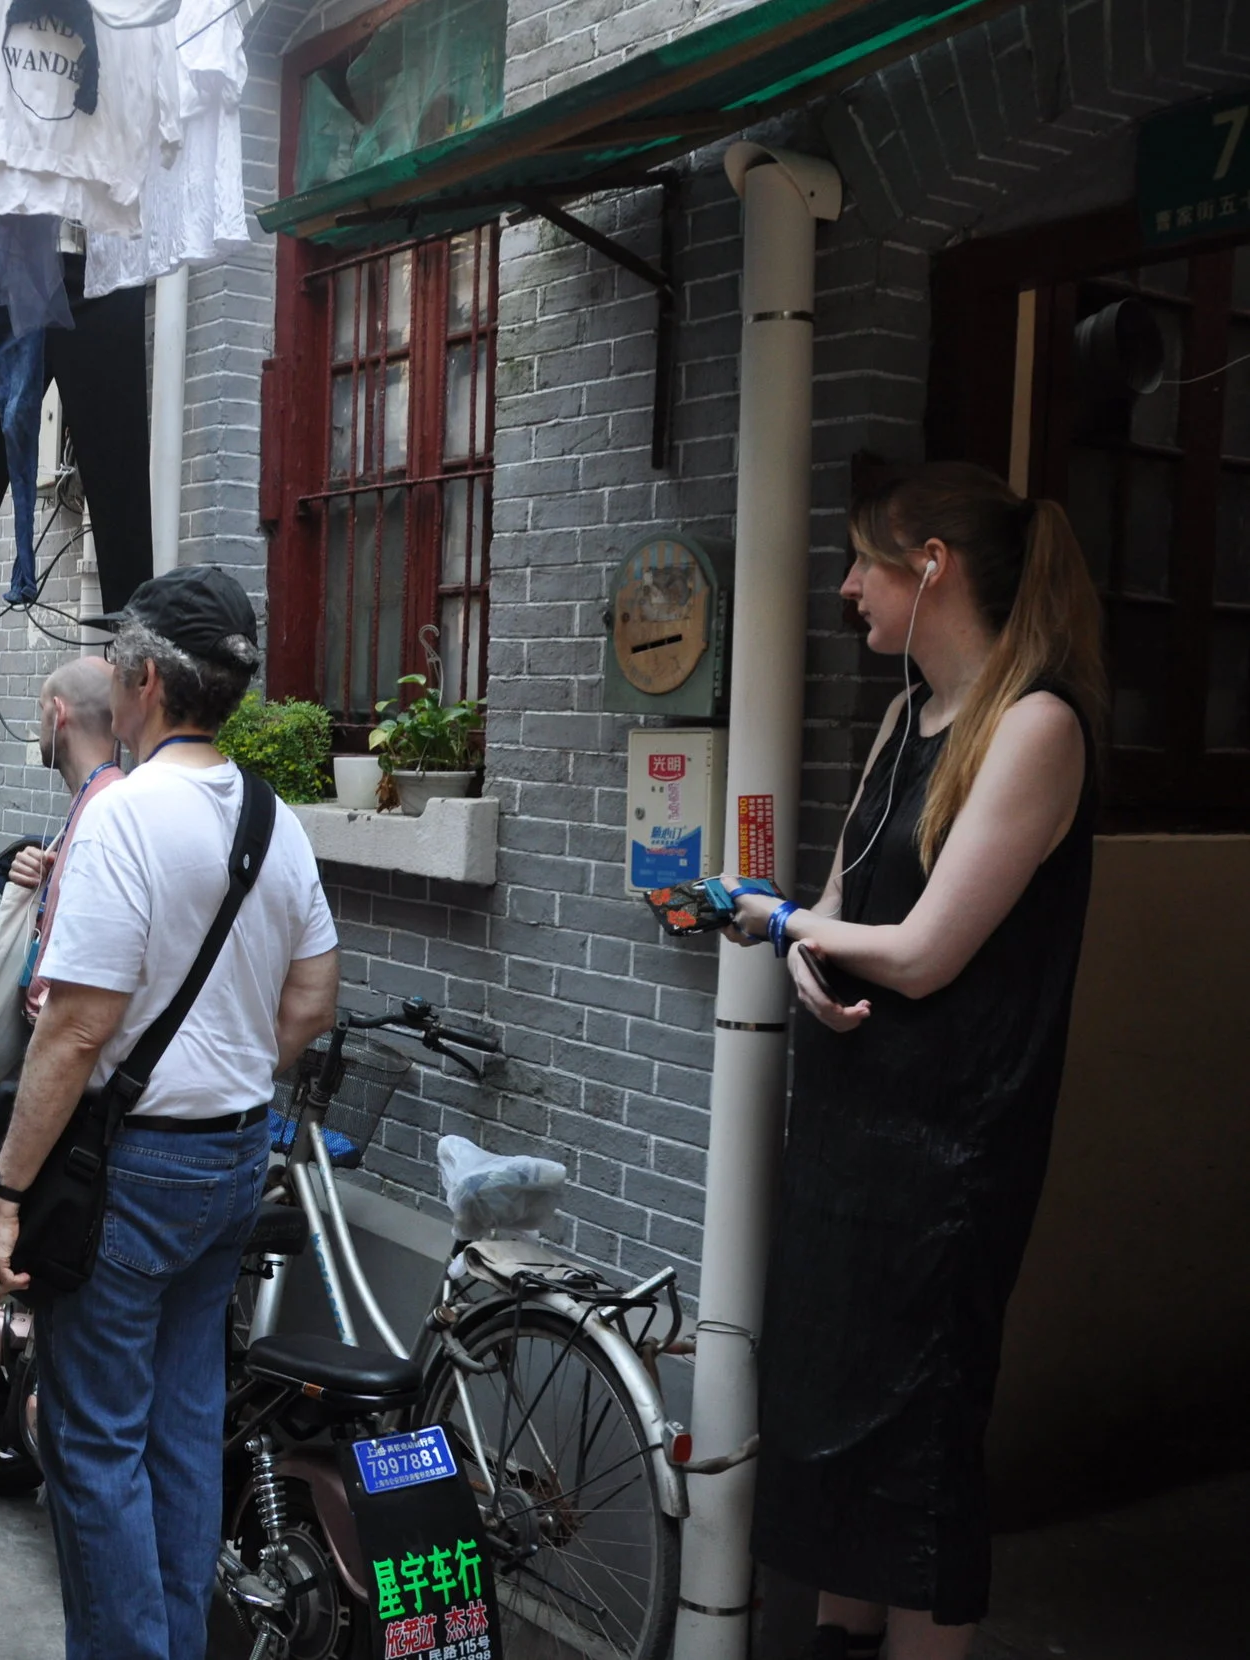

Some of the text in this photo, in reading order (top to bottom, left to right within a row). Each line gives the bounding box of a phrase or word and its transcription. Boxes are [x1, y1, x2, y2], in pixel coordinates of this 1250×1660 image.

[1212, 105, 1249, 180] 7
[653, 757, 682, 772] 光明
[367, 1446, 442, 1478] 7997881
[373, 1538, 482, 1620] 星宇车行
